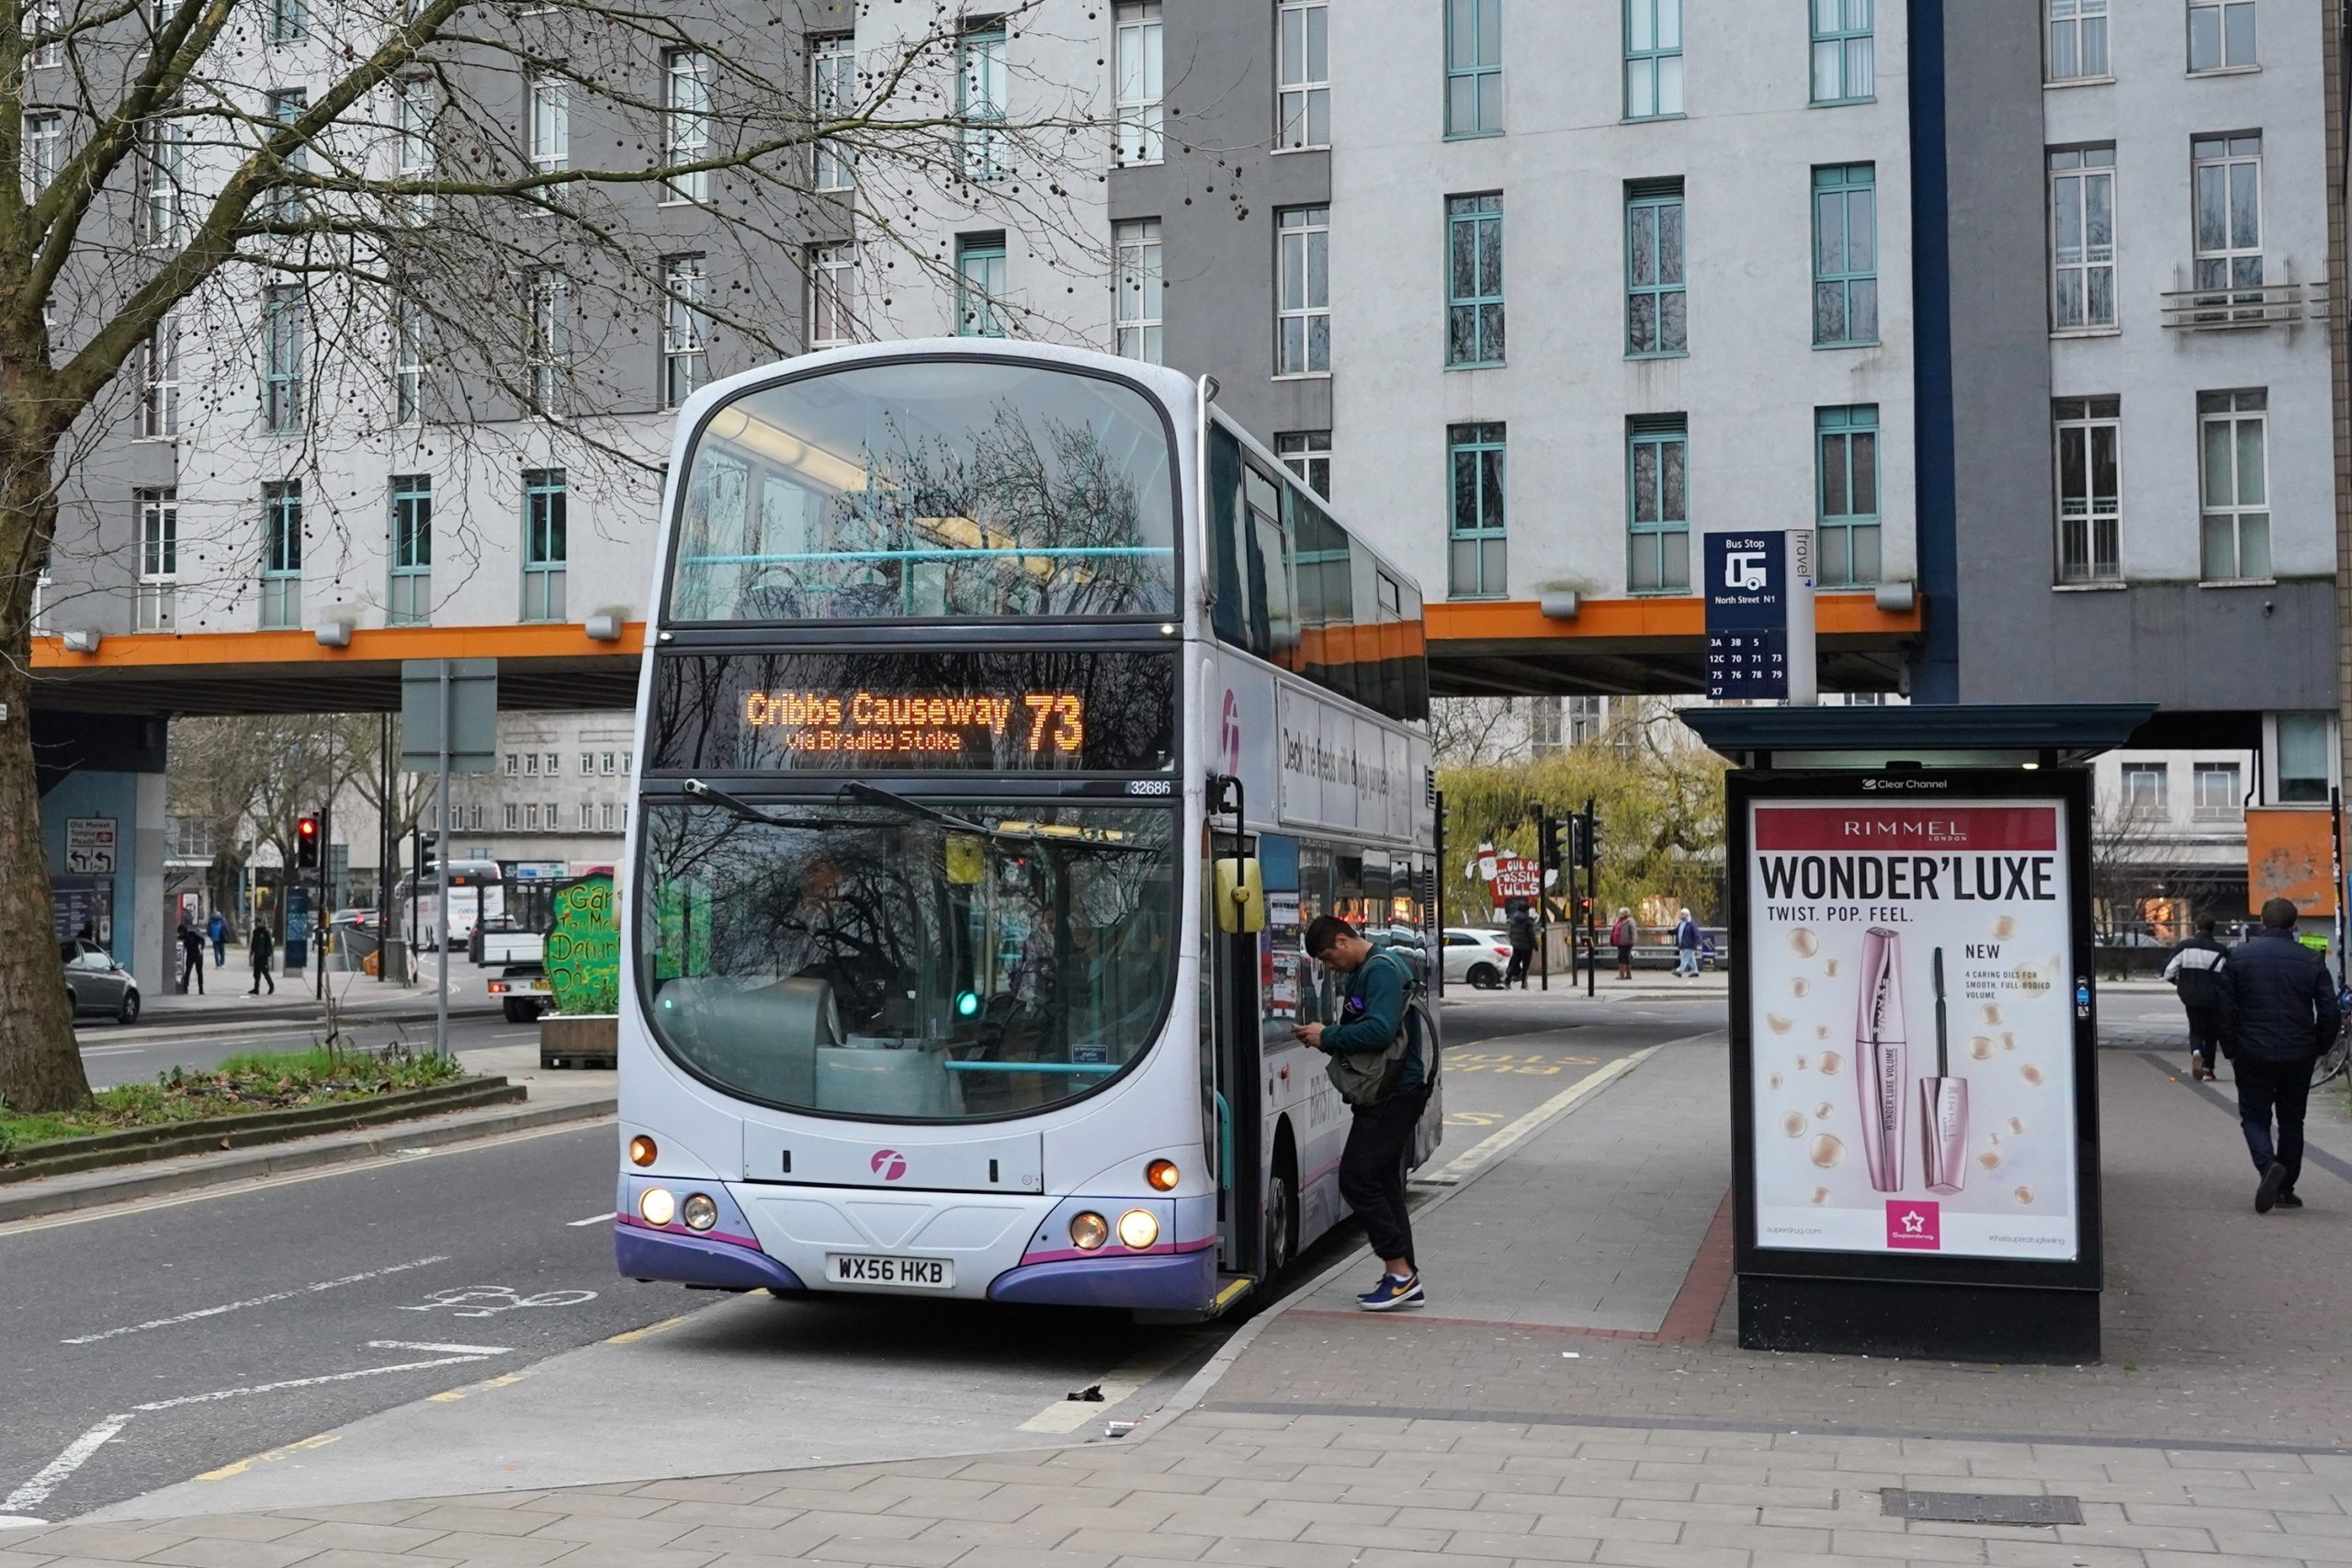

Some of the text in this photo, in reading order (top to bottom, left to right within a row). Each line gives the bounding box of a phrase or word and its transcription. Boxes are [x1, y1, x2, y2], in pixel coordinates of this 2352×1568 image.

[1725, 538, 1765, 550] Bus Stop
[1796, 533, 1811, 578] travel
[1714, 594, 1776, 604] North Street N1
[1710, 638, 1759, 647] 3A 3B 5
[1709, 654, 1782, 663] 12C 70 71 73
[1712, 671, 1782, 680] 75 76 78 79
[1712, 687, 1724, 696] X7
[747, 692, 1011, 735] Cribbs Causeway
[1024, 693, 1083, 751] 73
[786, 730, 961, 750] via Bradley Stoke
[1283, 727, 1305, 774] Deck
[1130, 781, 1171, 795] 32686
[1877, 780, 1948, 790] Clear Channel
[1844, 821, 1967, 836] RIMMEL
[1496, 871, 1540, 885] FOSSIL
[1758, 855, 2057, 901] WONDER'LUXE
[1497, 883, 1540, 897] FUELS
[1767, 906, 1915, 923] TWIST. POP. FEEL.
[1965, 943, 2001, 959] NEW
[1965, 981, 2051, 989] SMOOTH, FULL-BODIED
[1965, 991, 1996, 999] VOLUME
[1884, 1047, 1894, 1077] VOLUME
[1766, 1225, 1823, 1235] superdrug.com
[839, 1258, 943, 1283] WX56 HKB
